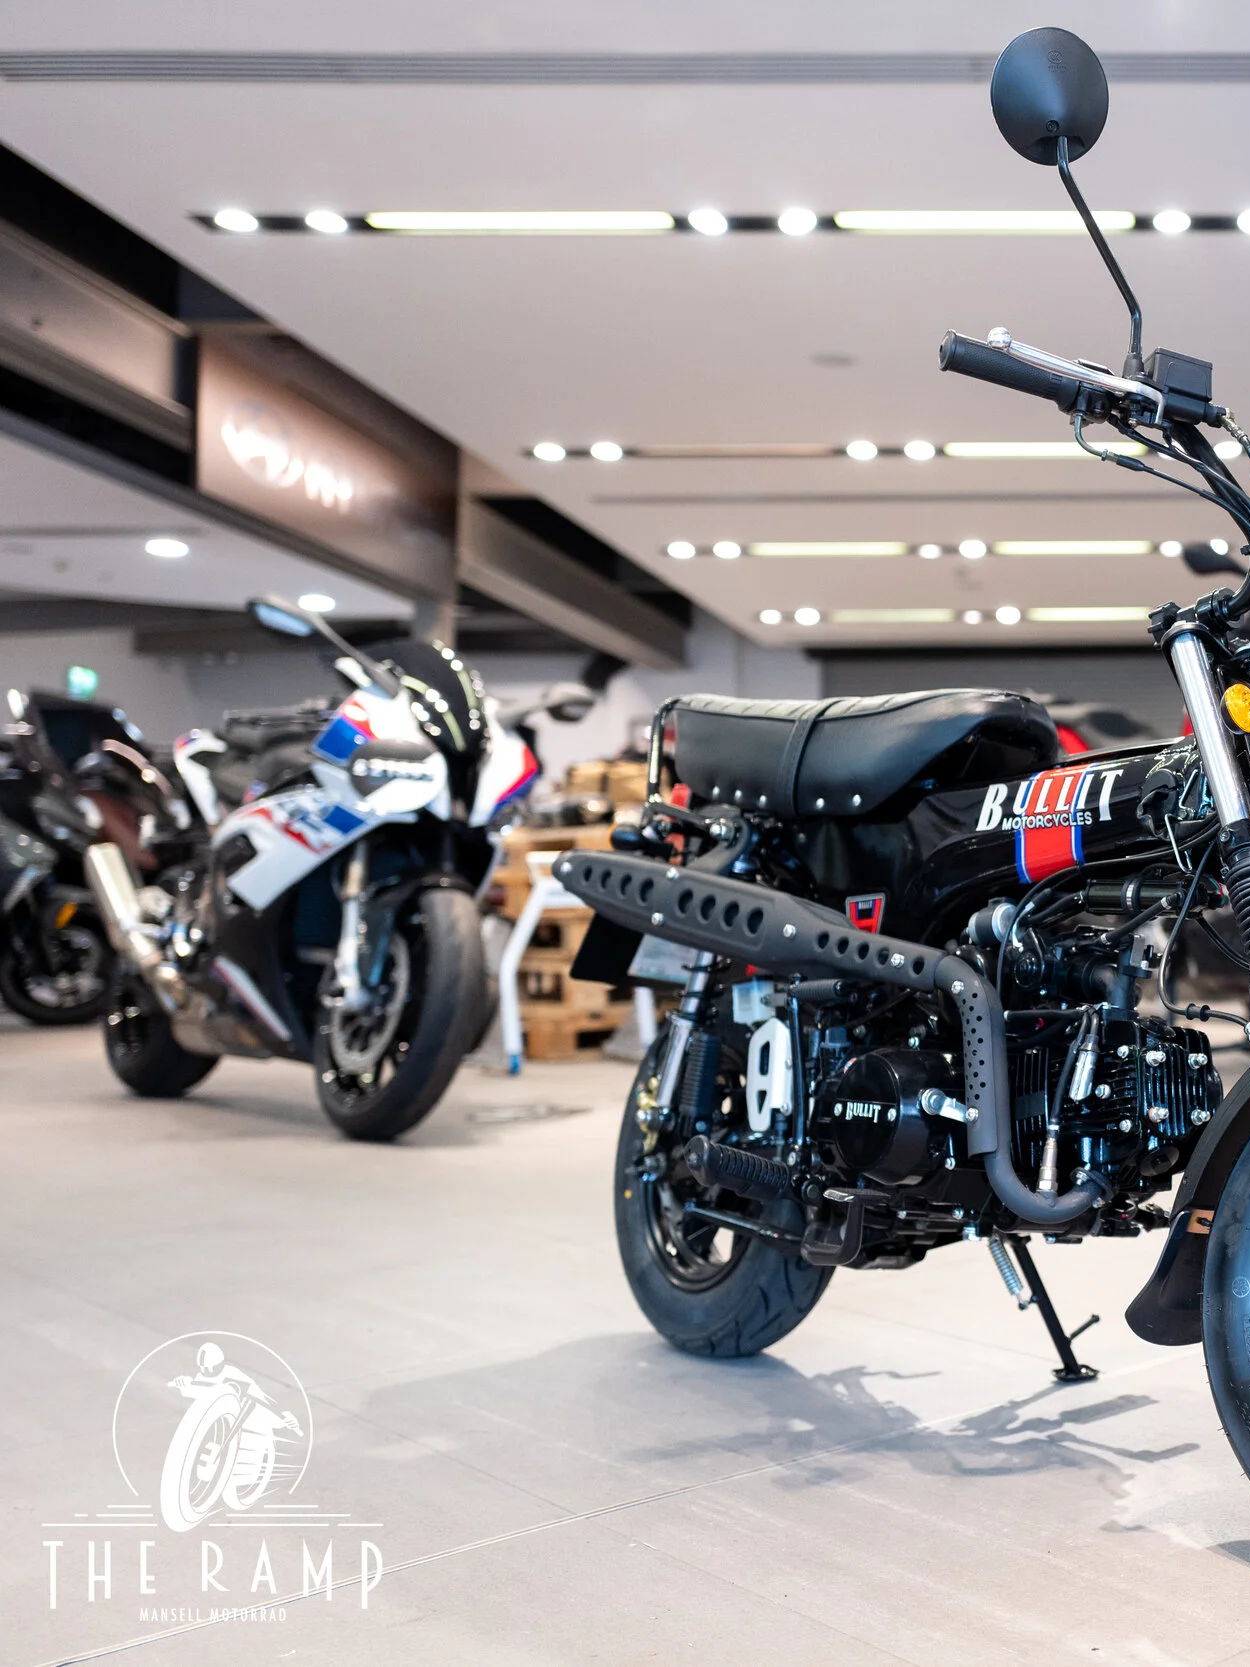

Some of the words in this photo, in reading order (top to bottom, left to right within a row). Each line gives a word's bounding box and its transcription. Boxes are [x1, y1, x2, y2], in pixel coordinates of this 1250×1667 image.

[976, 769, 1124, 832] BULLIT
[1001, 811, 1093, 831] MOTORCYCLES
[845, 1101, 881, 1123] BULLIT
